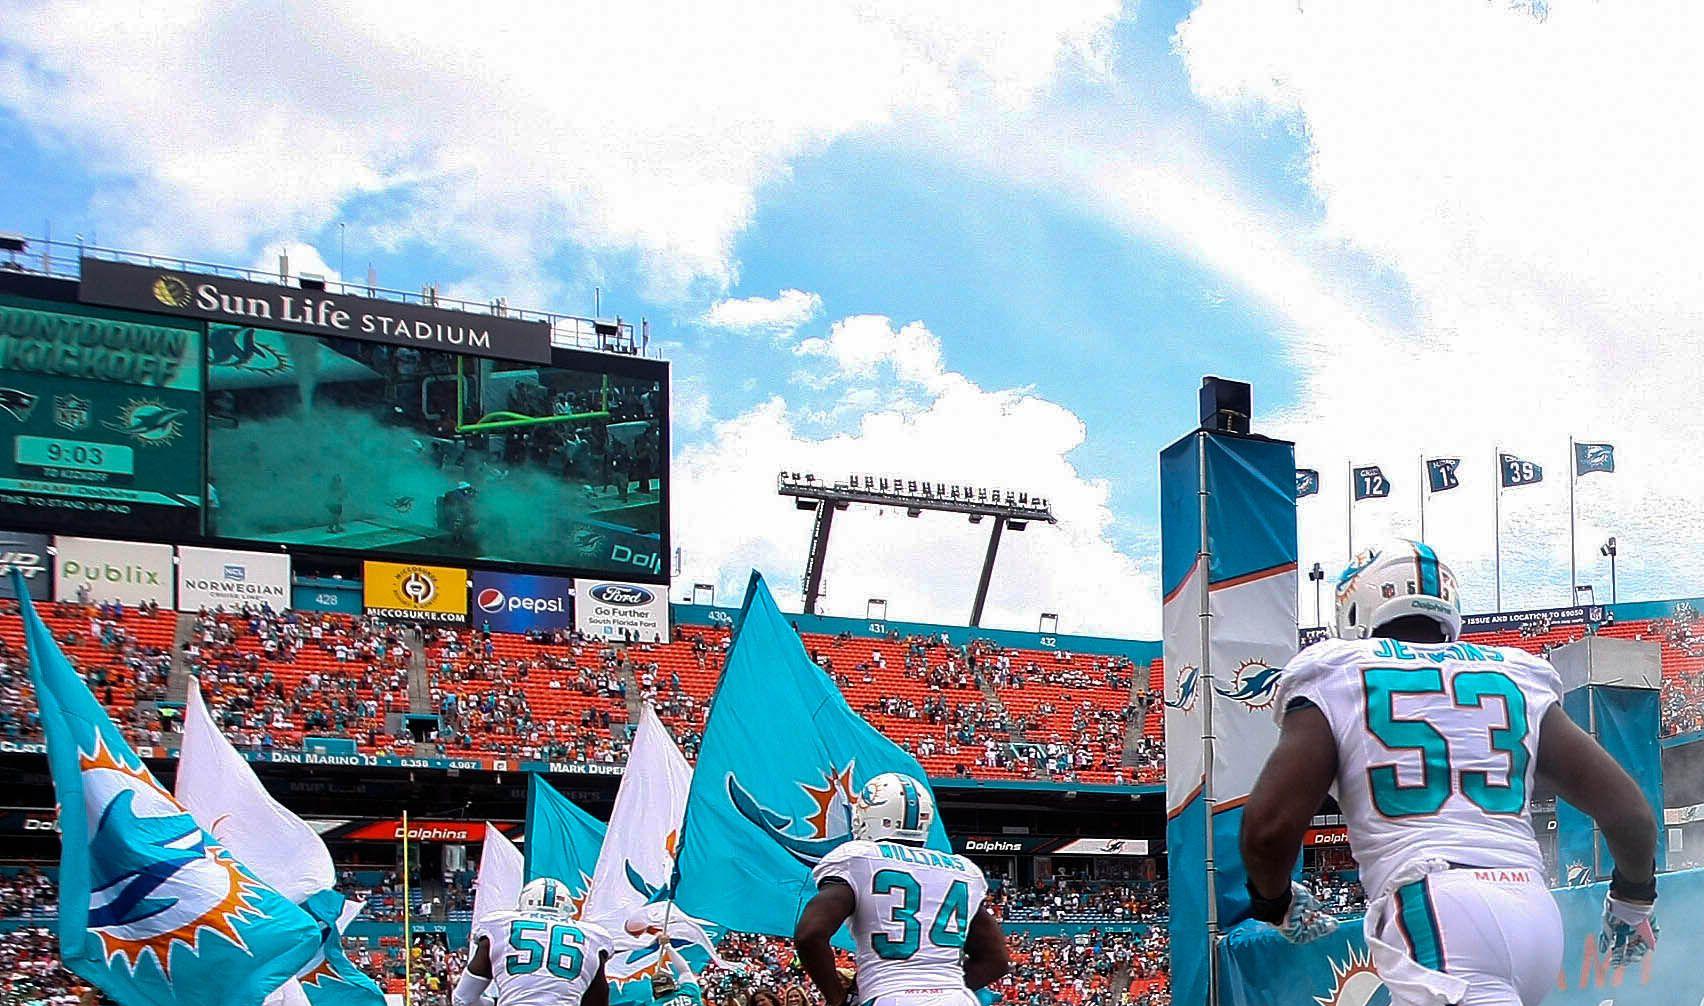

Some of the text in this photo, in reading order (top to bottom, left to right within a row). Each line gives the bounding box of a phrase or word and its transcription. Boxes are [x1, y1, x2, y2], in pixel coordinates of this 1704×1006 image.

[196, 284, 491, 349] Sun Life STADIUM
[47, 443, 104, 466] 9:03
[1364, 476, 1384, 495] 12
[184, 579, 284, 596] NORWEGIAN
[315, 593, 338, 606] 428
[602, 586, 642, 605] Ford
[508, 596, 563, 614] pepsi
[595, 606, 649, 619] Go Further
[1467, 617, 1490, 625] ISSUE
[1510, 612, 1548, 623] LOCATION
[588, 617, 656, 628] South Florida Ford
[868, 622, 885, 633] 431
[1039, 636, 1057, 647] 432
[1363, 667, 1533, 819] 53
[271, 752, 301, 764] DAN
[305, 753, 358, 766] MARINO
[359, 752, 378, 766] 13
[550, 762, 626, 775] MARK DUPER
[394, 827, 468, 840] Dolphins
[966, 840, 1022, 853] Dolphins
[878, 844, 966, 872] WILLIAMS
[1474, 870, 1530, 883] MIAMI
[871, 869, 969, 960] 34
[505, 919, 587, 981] 56
